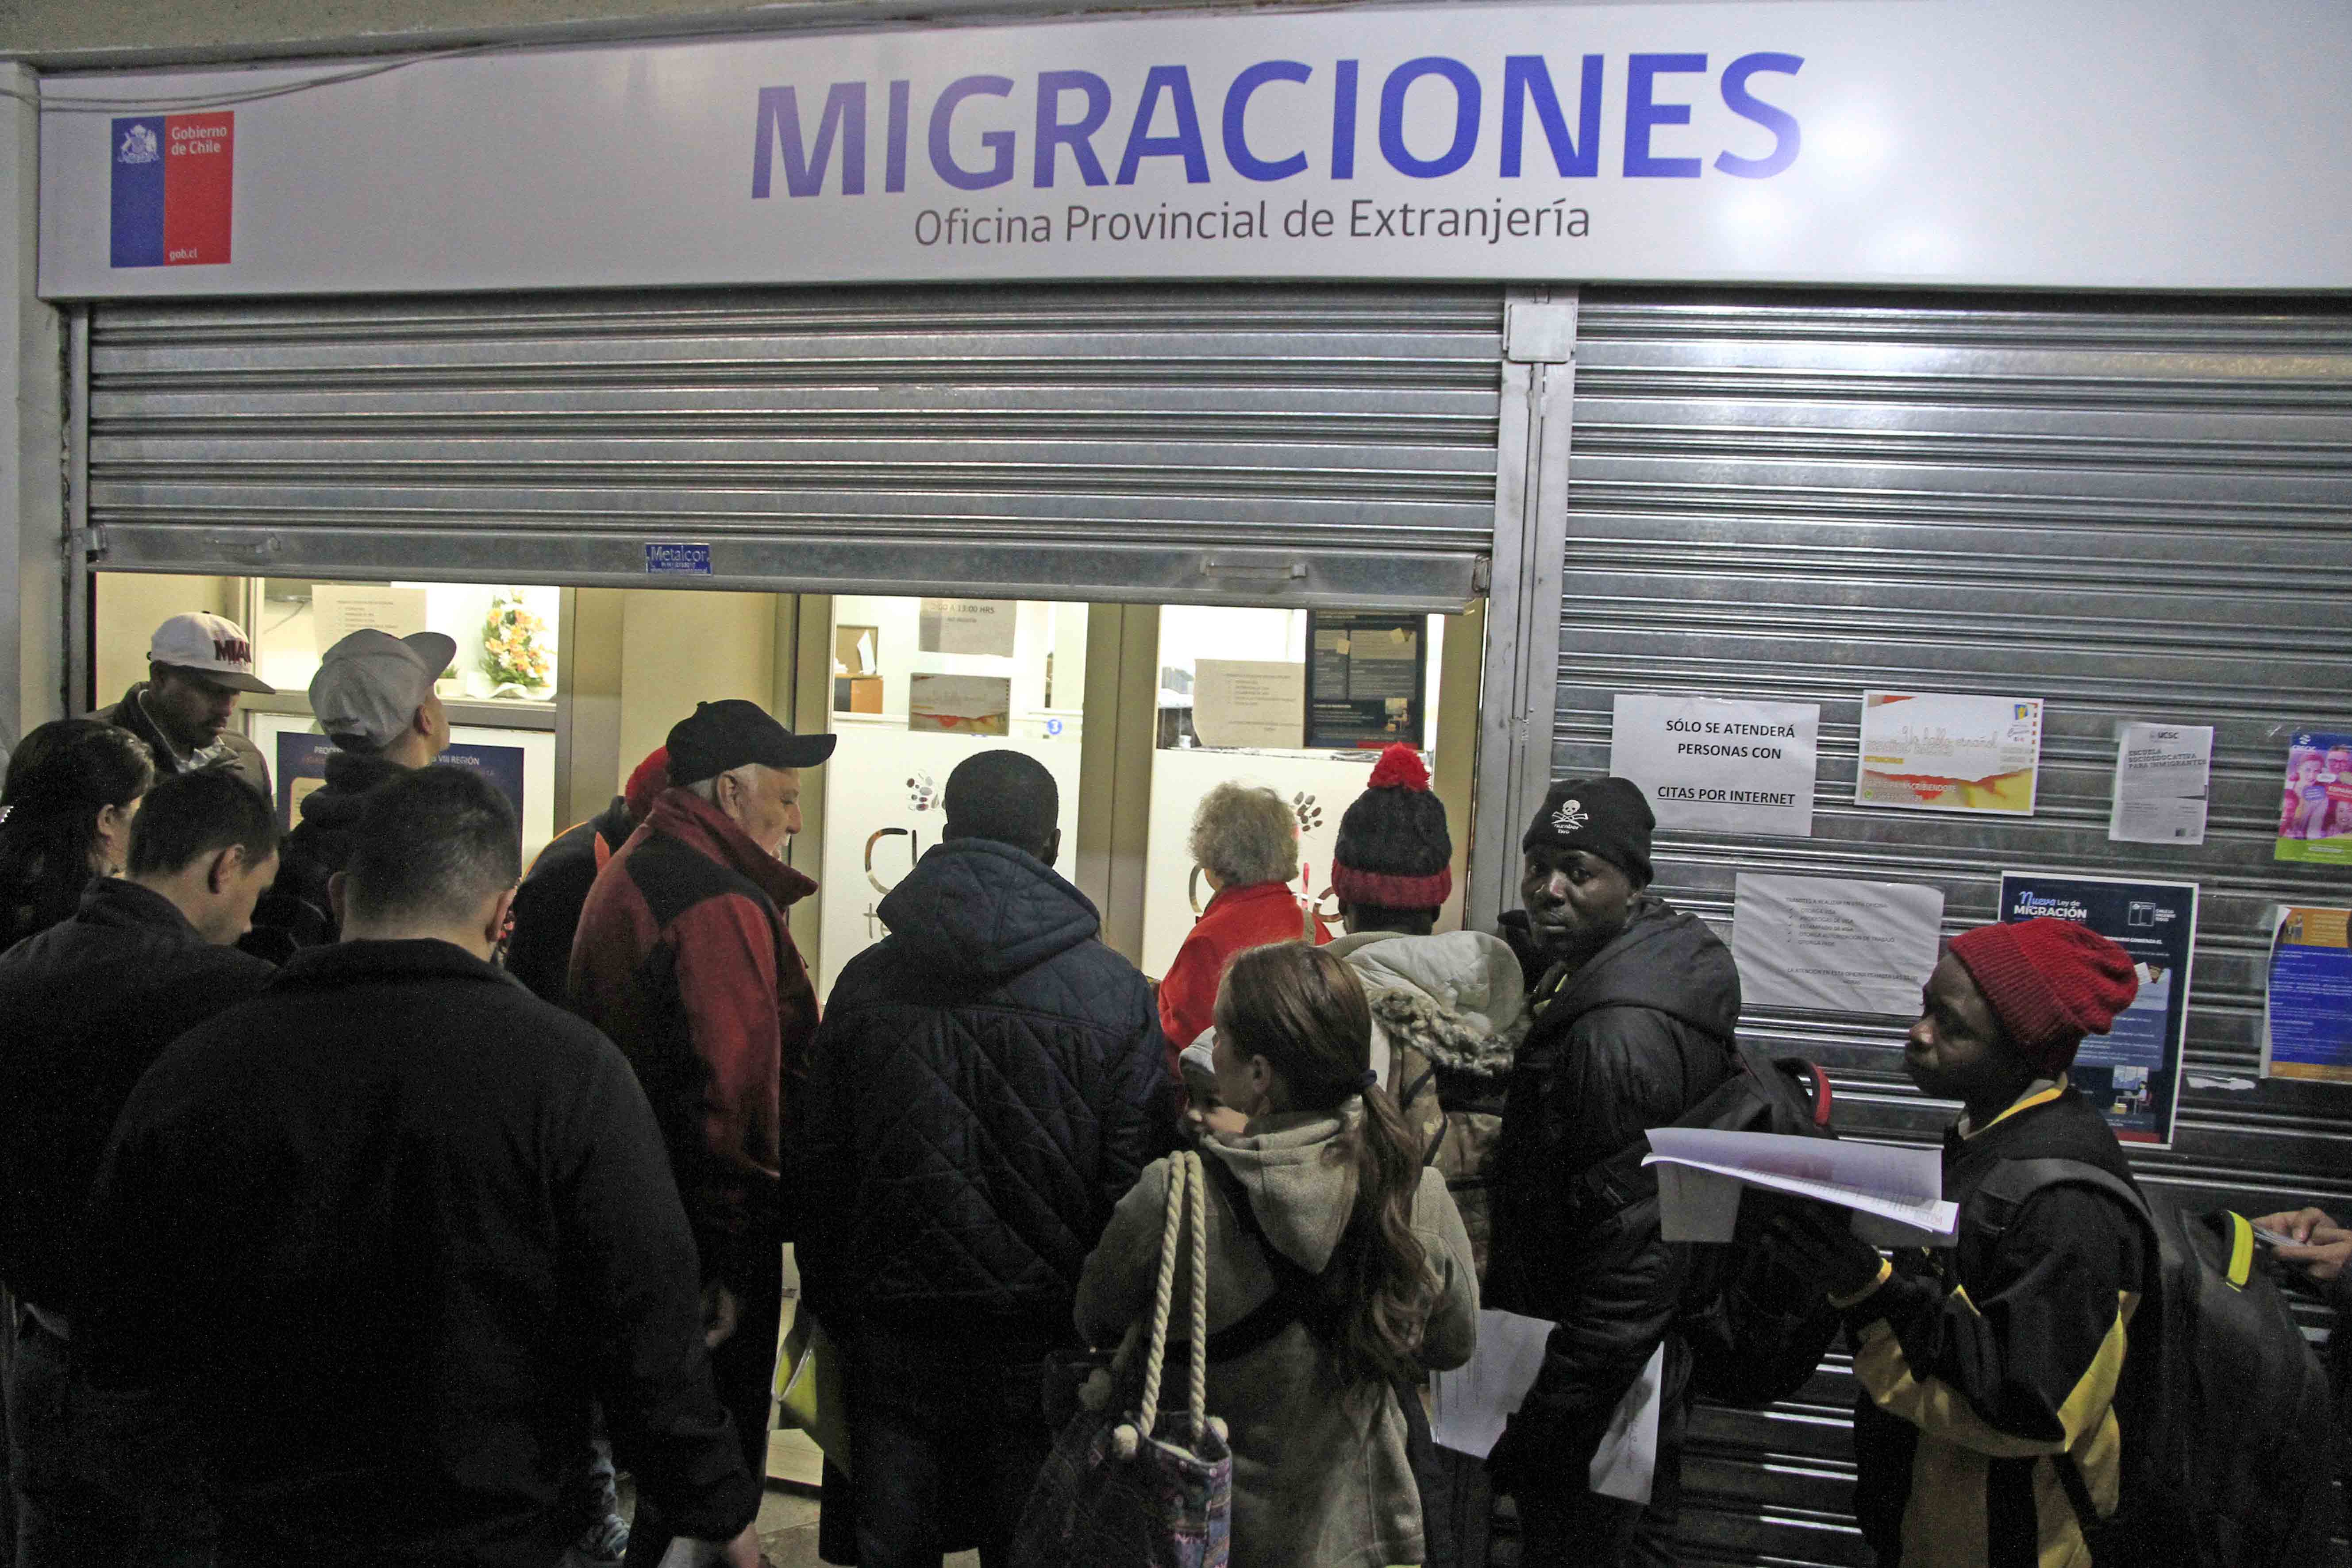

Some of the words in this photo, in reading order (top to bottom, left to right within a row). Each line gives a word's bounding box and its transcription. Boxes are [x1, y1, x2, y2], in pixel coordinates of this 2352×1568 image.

[171, 125, 227, 140] Gobierno
[752, 52, 1805, 199] MIGRACIONES
[171, 143, 186, 156] de
[189, 141, 221, 154] Chile
[915, 207, 1051, 246] Oficina
[1066, 200, 1268, 242] Provincial
[1284, 199, 1334, 237] de
[1350, 197, 1590, 245] Extranjería
[169, 248, 198, 261] gob.cl
[1666, 718, 1701, 732] SÓLO
[1705, 722, 1720, 733] SE
[1724, 723, 1795, 738] ATENDERÁ
[1678, 744, 1748, 758] PERSONAS
[1752, 747, 1781, 759] CON
[451, 755, 480, 765] REGIÓN
[1658, 786, 1694, 798] CITAS
[1699, 789, 1725, 801] POR
[1731, 790, 1795, 805] INTERNET
[2014, 905, 2087, 918] MIGRACIÓN
